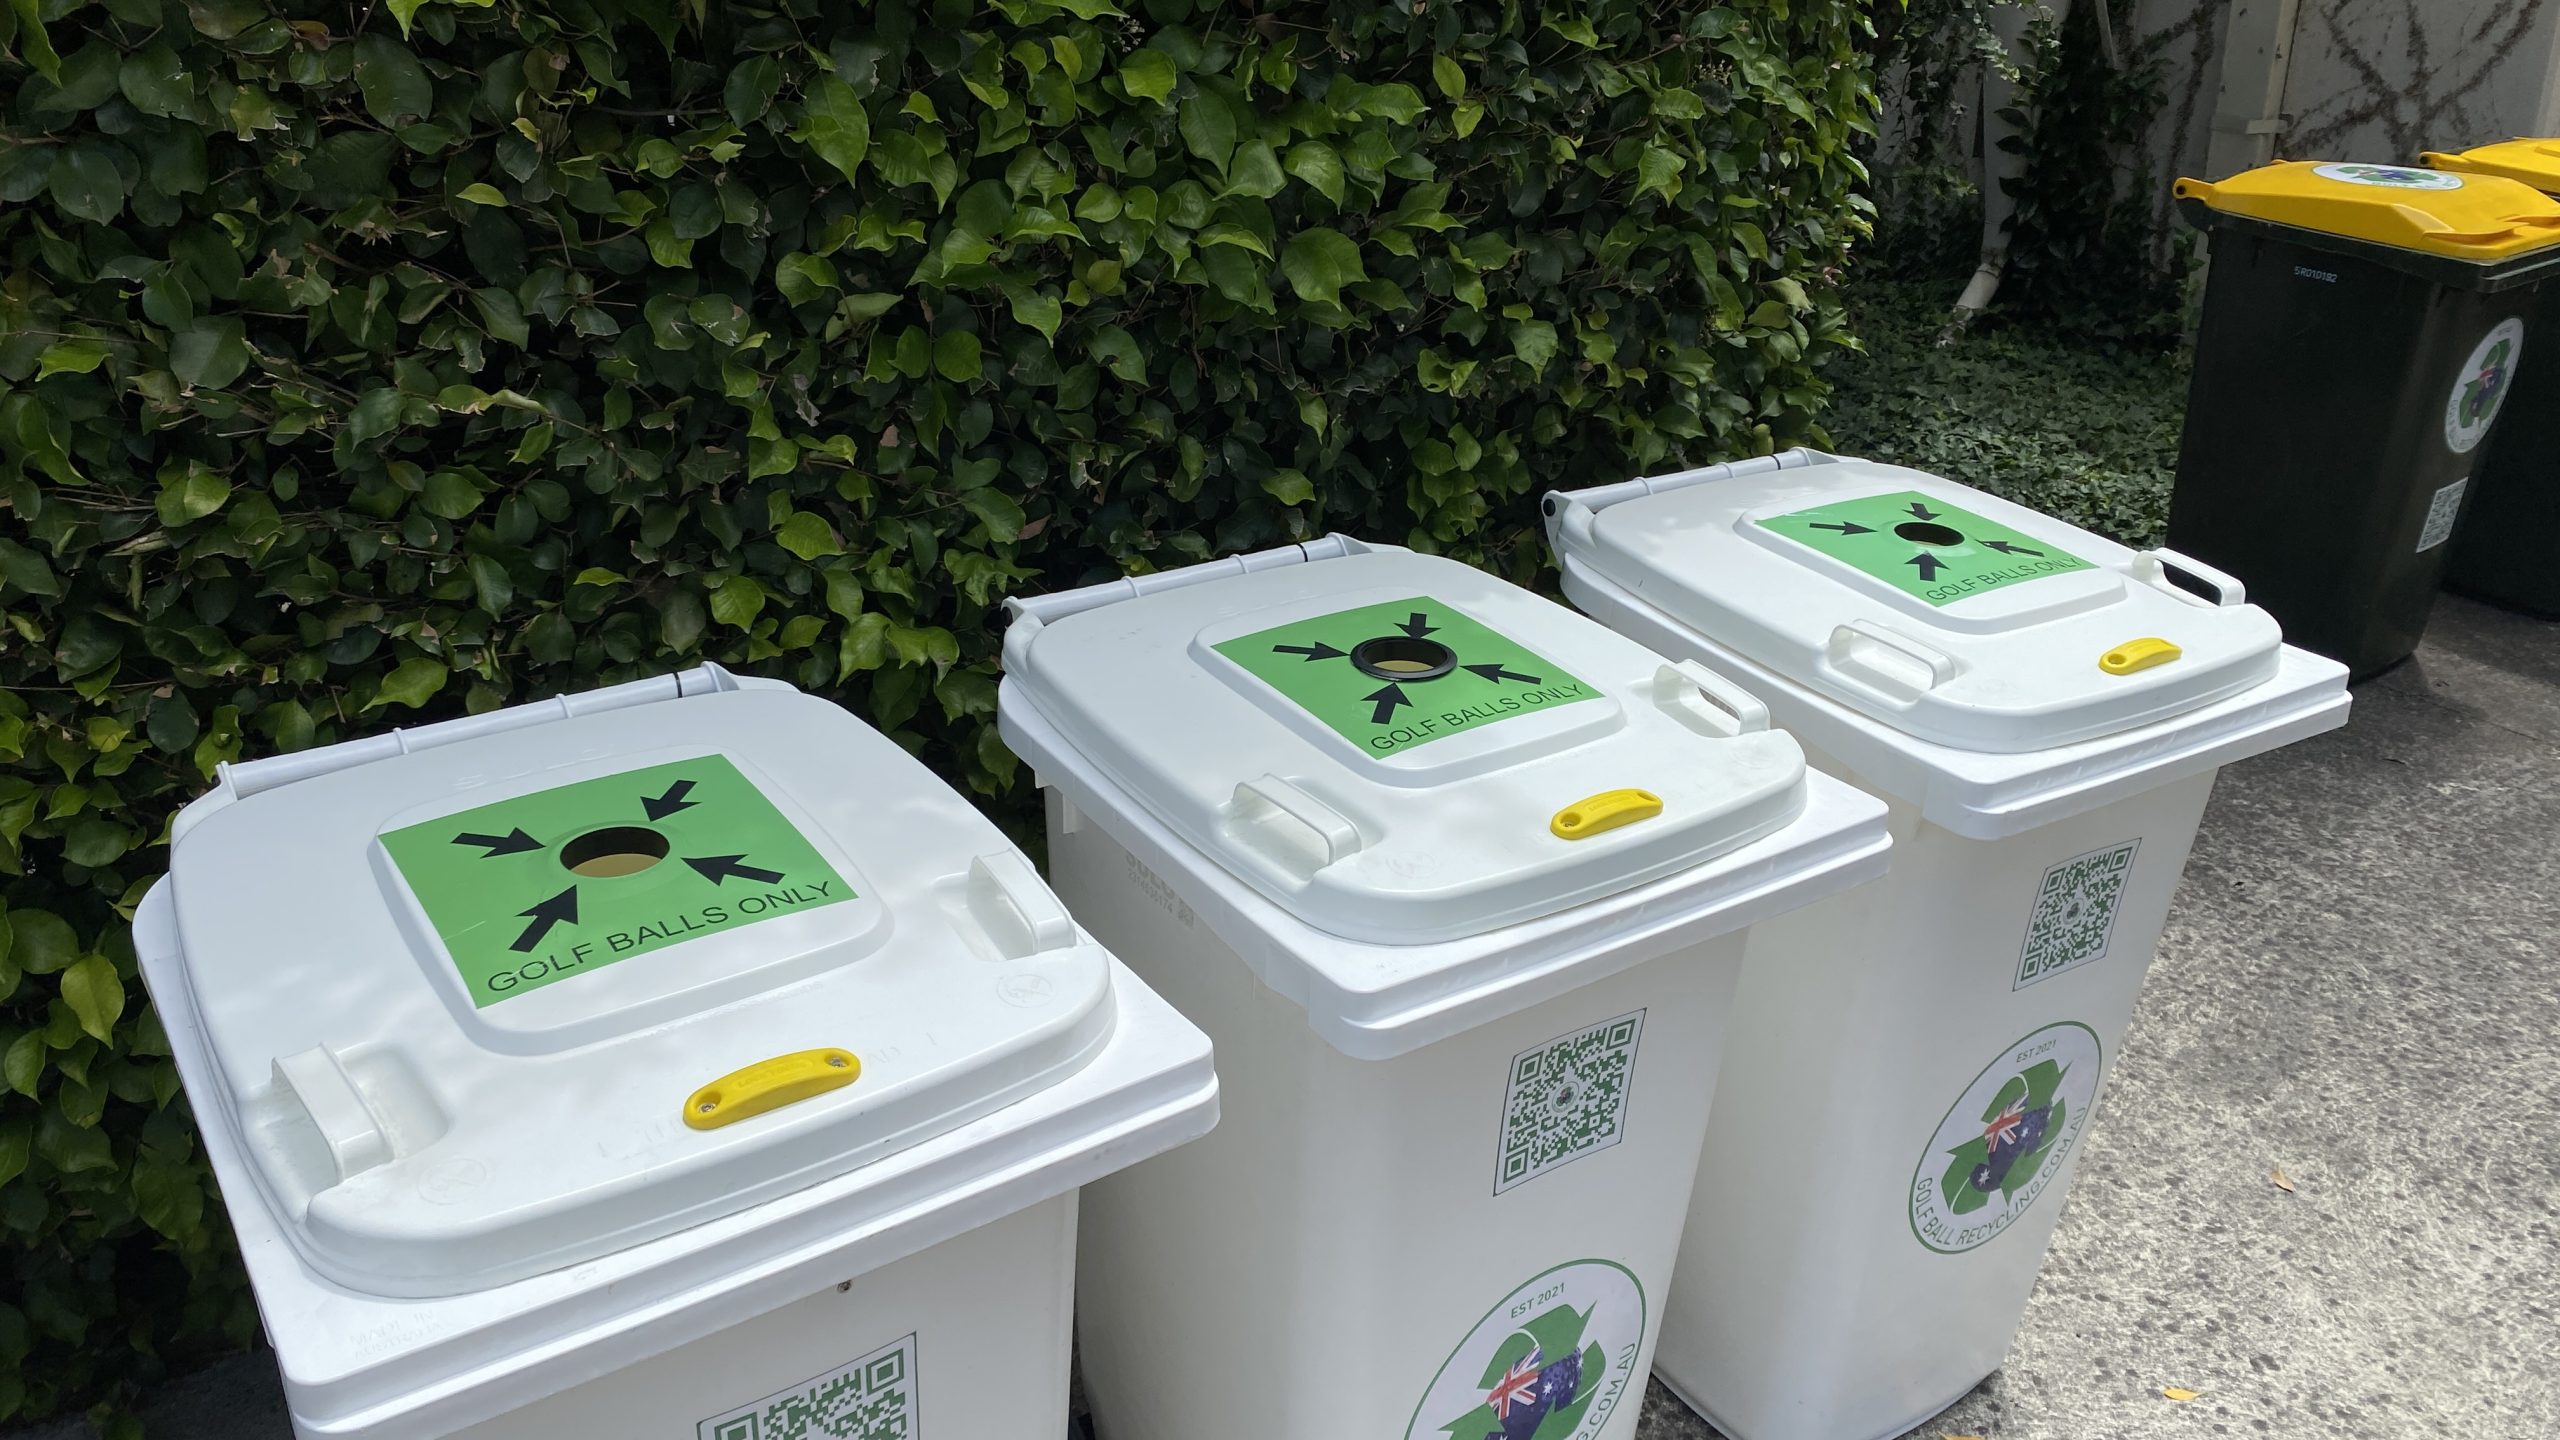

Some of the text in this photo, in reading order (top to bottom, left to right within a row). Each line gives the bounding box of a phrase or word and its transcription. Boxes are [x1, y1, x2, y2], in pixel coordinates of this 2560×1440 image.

[1926, 557, 2082, 600] GOLF BALLS ONLY
[1370, 683, 1583, 751] GOLF BALLS ONLY
[487, 880, 832, 992] GOLF BALLS ONLY
[2016, 1048, 2035, 1063] EST
[1915, 1177, 1934, 1219] GOLF
[1923, 1216, 1954, 1246] BALL
[1511, 1282, 1565, 1319] EST 2021
